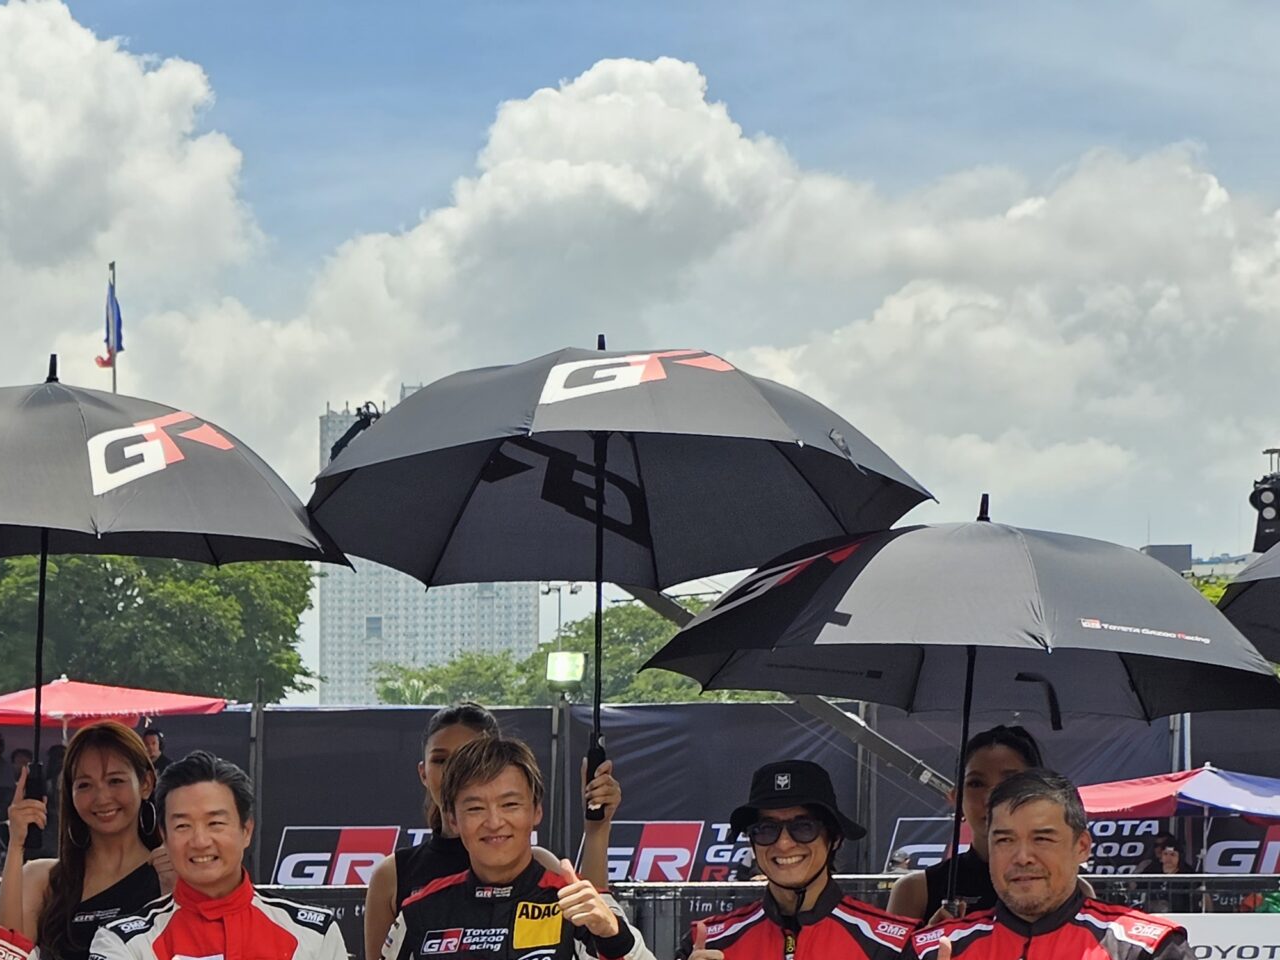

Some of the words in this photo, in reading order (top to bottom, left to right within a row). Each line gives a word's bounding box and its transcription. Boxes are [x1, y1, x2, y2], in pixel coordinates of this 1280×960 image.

[87, 410, 235, 496] GR
[297, 909, 325, 923] OMP
[518, 902, 562, 920] ADAC
[465, 928, 509, 936] TOYOTA
[876, 922, 908, 937] OMP
[915, 929, 945, 944] OMP
[1131, 923, 1164, 938] OMP
[423, 938, 458, 952] GR
[462, 935, 504, 943] GAZOO
[1192, 945, 1280, 959] OYOT
